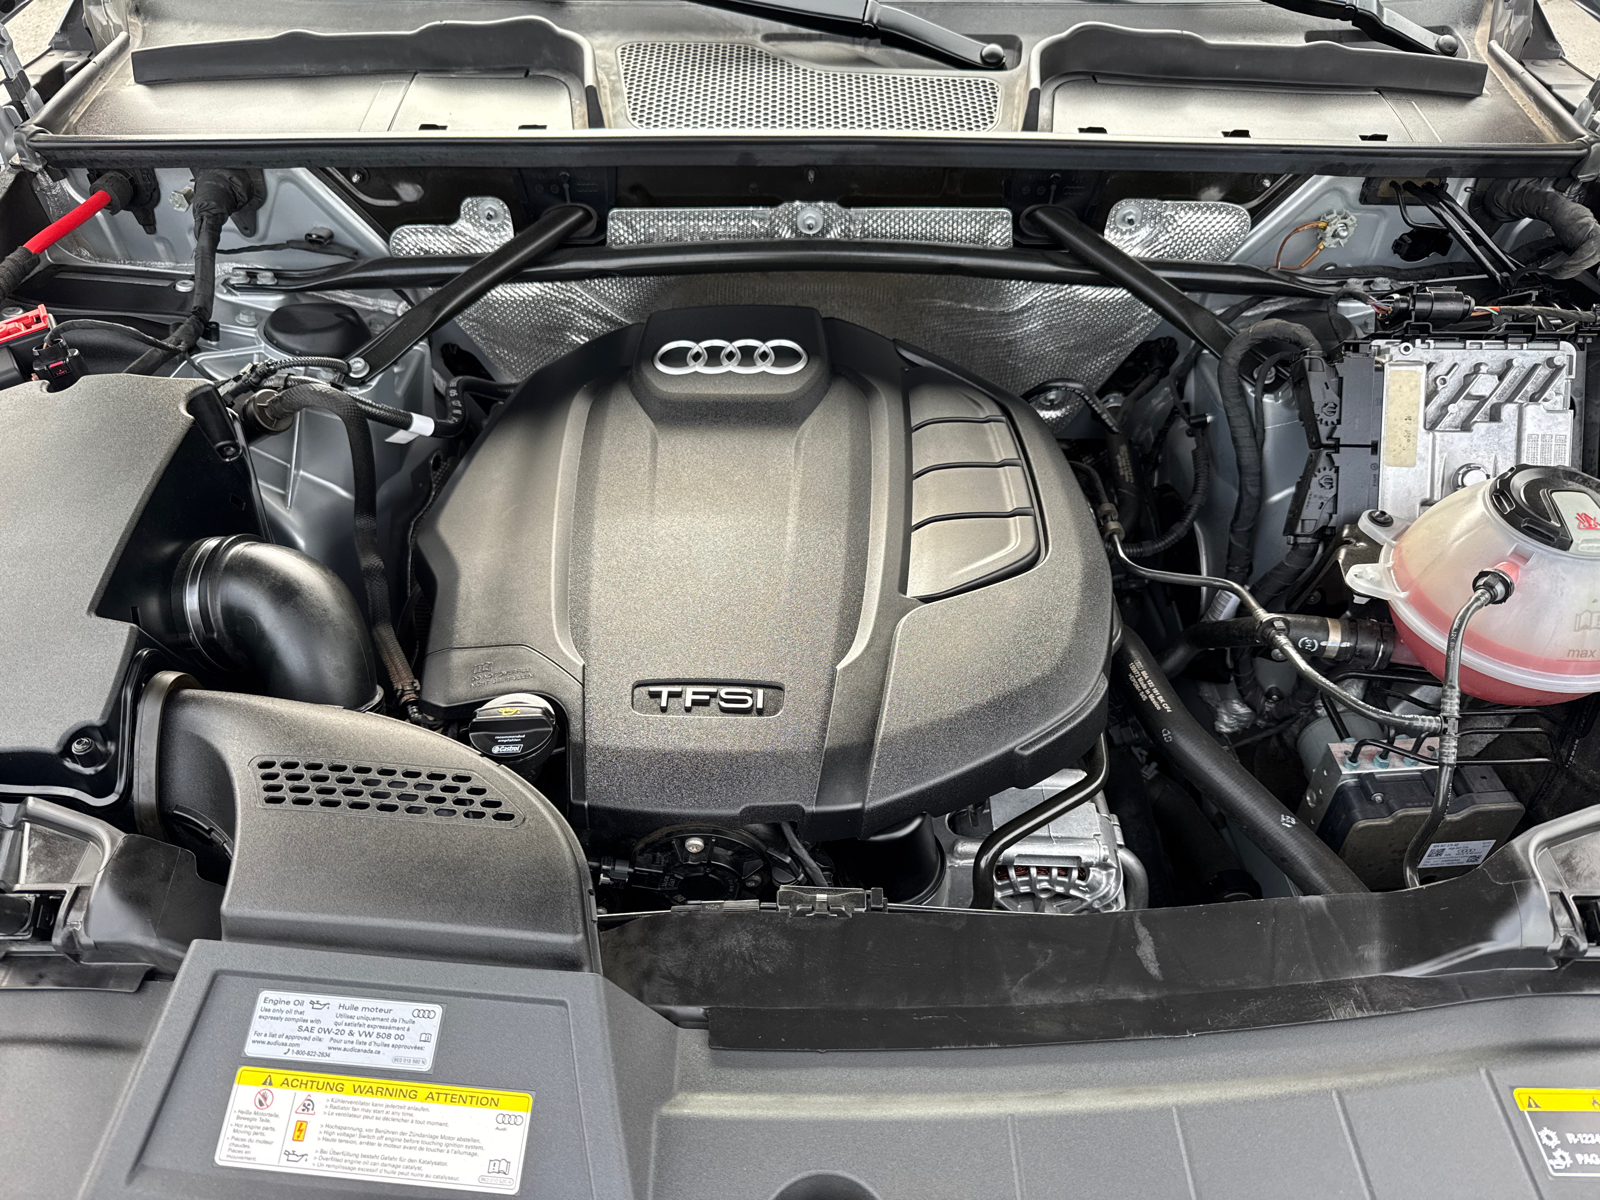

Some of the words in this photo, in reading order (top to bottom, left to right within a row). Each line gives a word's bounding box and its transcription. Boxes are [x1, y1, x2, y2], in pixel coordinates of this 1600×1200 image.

[1566, 650, 1596, 658] max
[1146, 679, 1154, 688] 122
[1138, 676, 1147, 690] Made
[1148, 694, 1161, 710] Mexico
[648, 688, 764, 712] TFSI
[263, 997, 291, 1006] Engine
[317, 1028, 345, 1036] 0W-20
[328, 1046, 381, 1054] www.audicanada.ca
[280, 1077, 345, 1092] ACHTUNG
[352, 1084, 418, 1099] WARNING
[424, 1092, 500, 1107] ATTENTION
[331, 1098, 370, 1106] Kühlerventilator
[409, 1131, 439, 1140] Zündanlage
[329, 1149, 359, 1158] Überfüllung
[418, 1158, 448, 1167] Katalysator.
